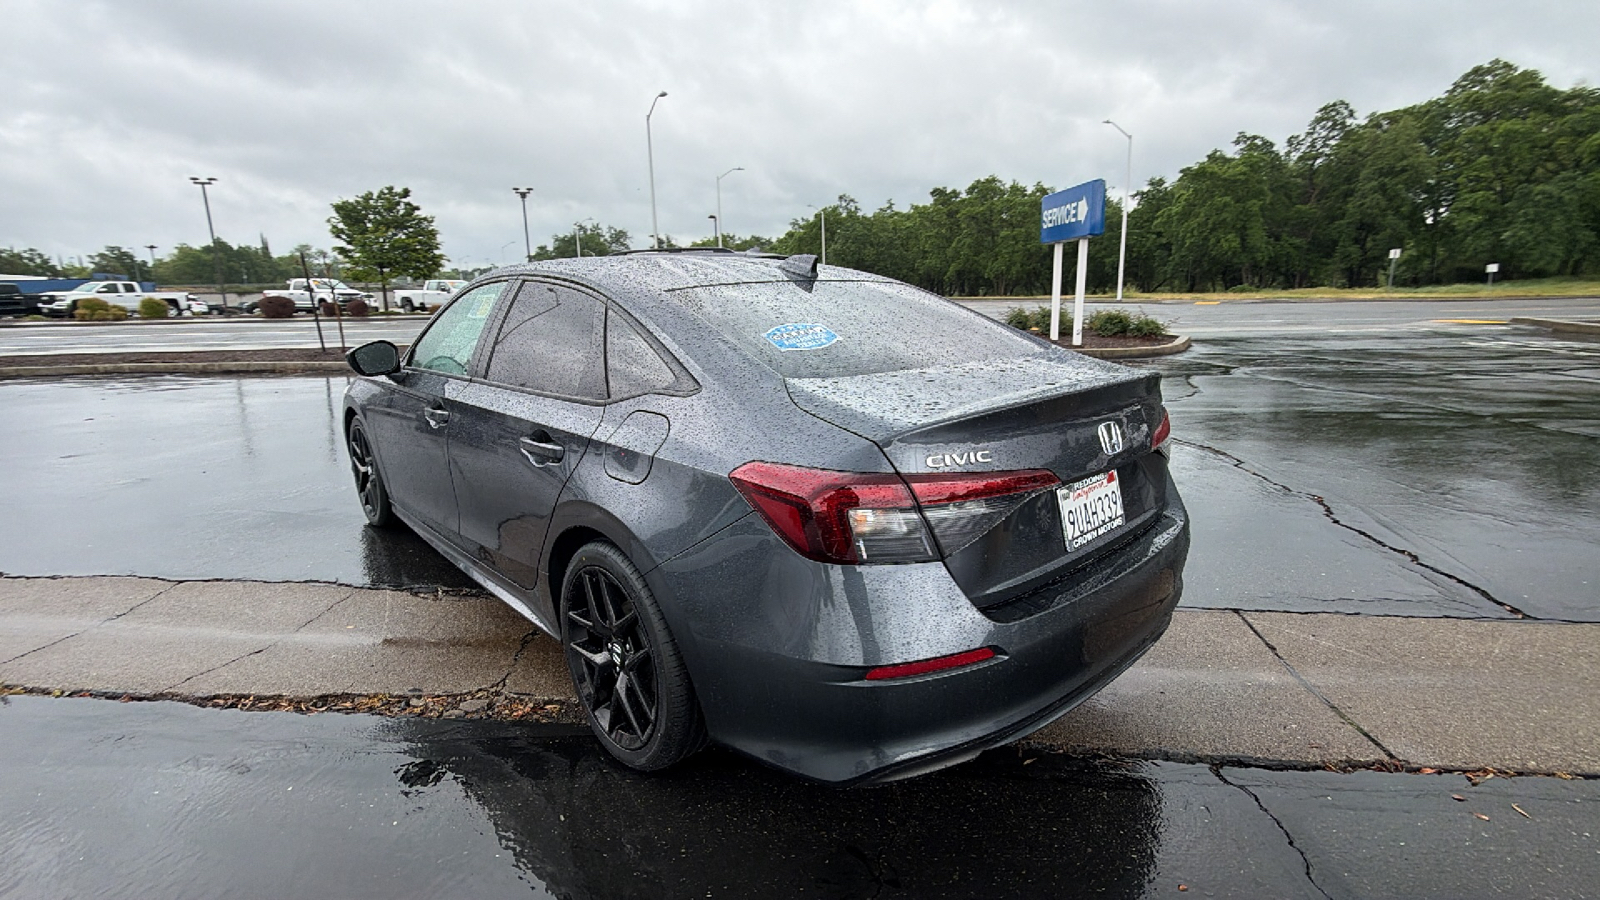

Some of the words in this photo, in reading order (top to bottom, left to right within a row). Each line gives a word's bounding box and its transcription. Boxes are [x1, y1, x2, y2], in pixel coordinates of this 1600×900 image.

[1042, 202, 1077, 229] SERVICE
[926, 450, 992, 468] CIVIC
[1074, 473, 1108, 490] REDDING
[1067, 490, 1118, 540] 9UAH339
[1073, 529, 1097, 548] CROWN
[1098, 517, 1123, 536] MOTORS
